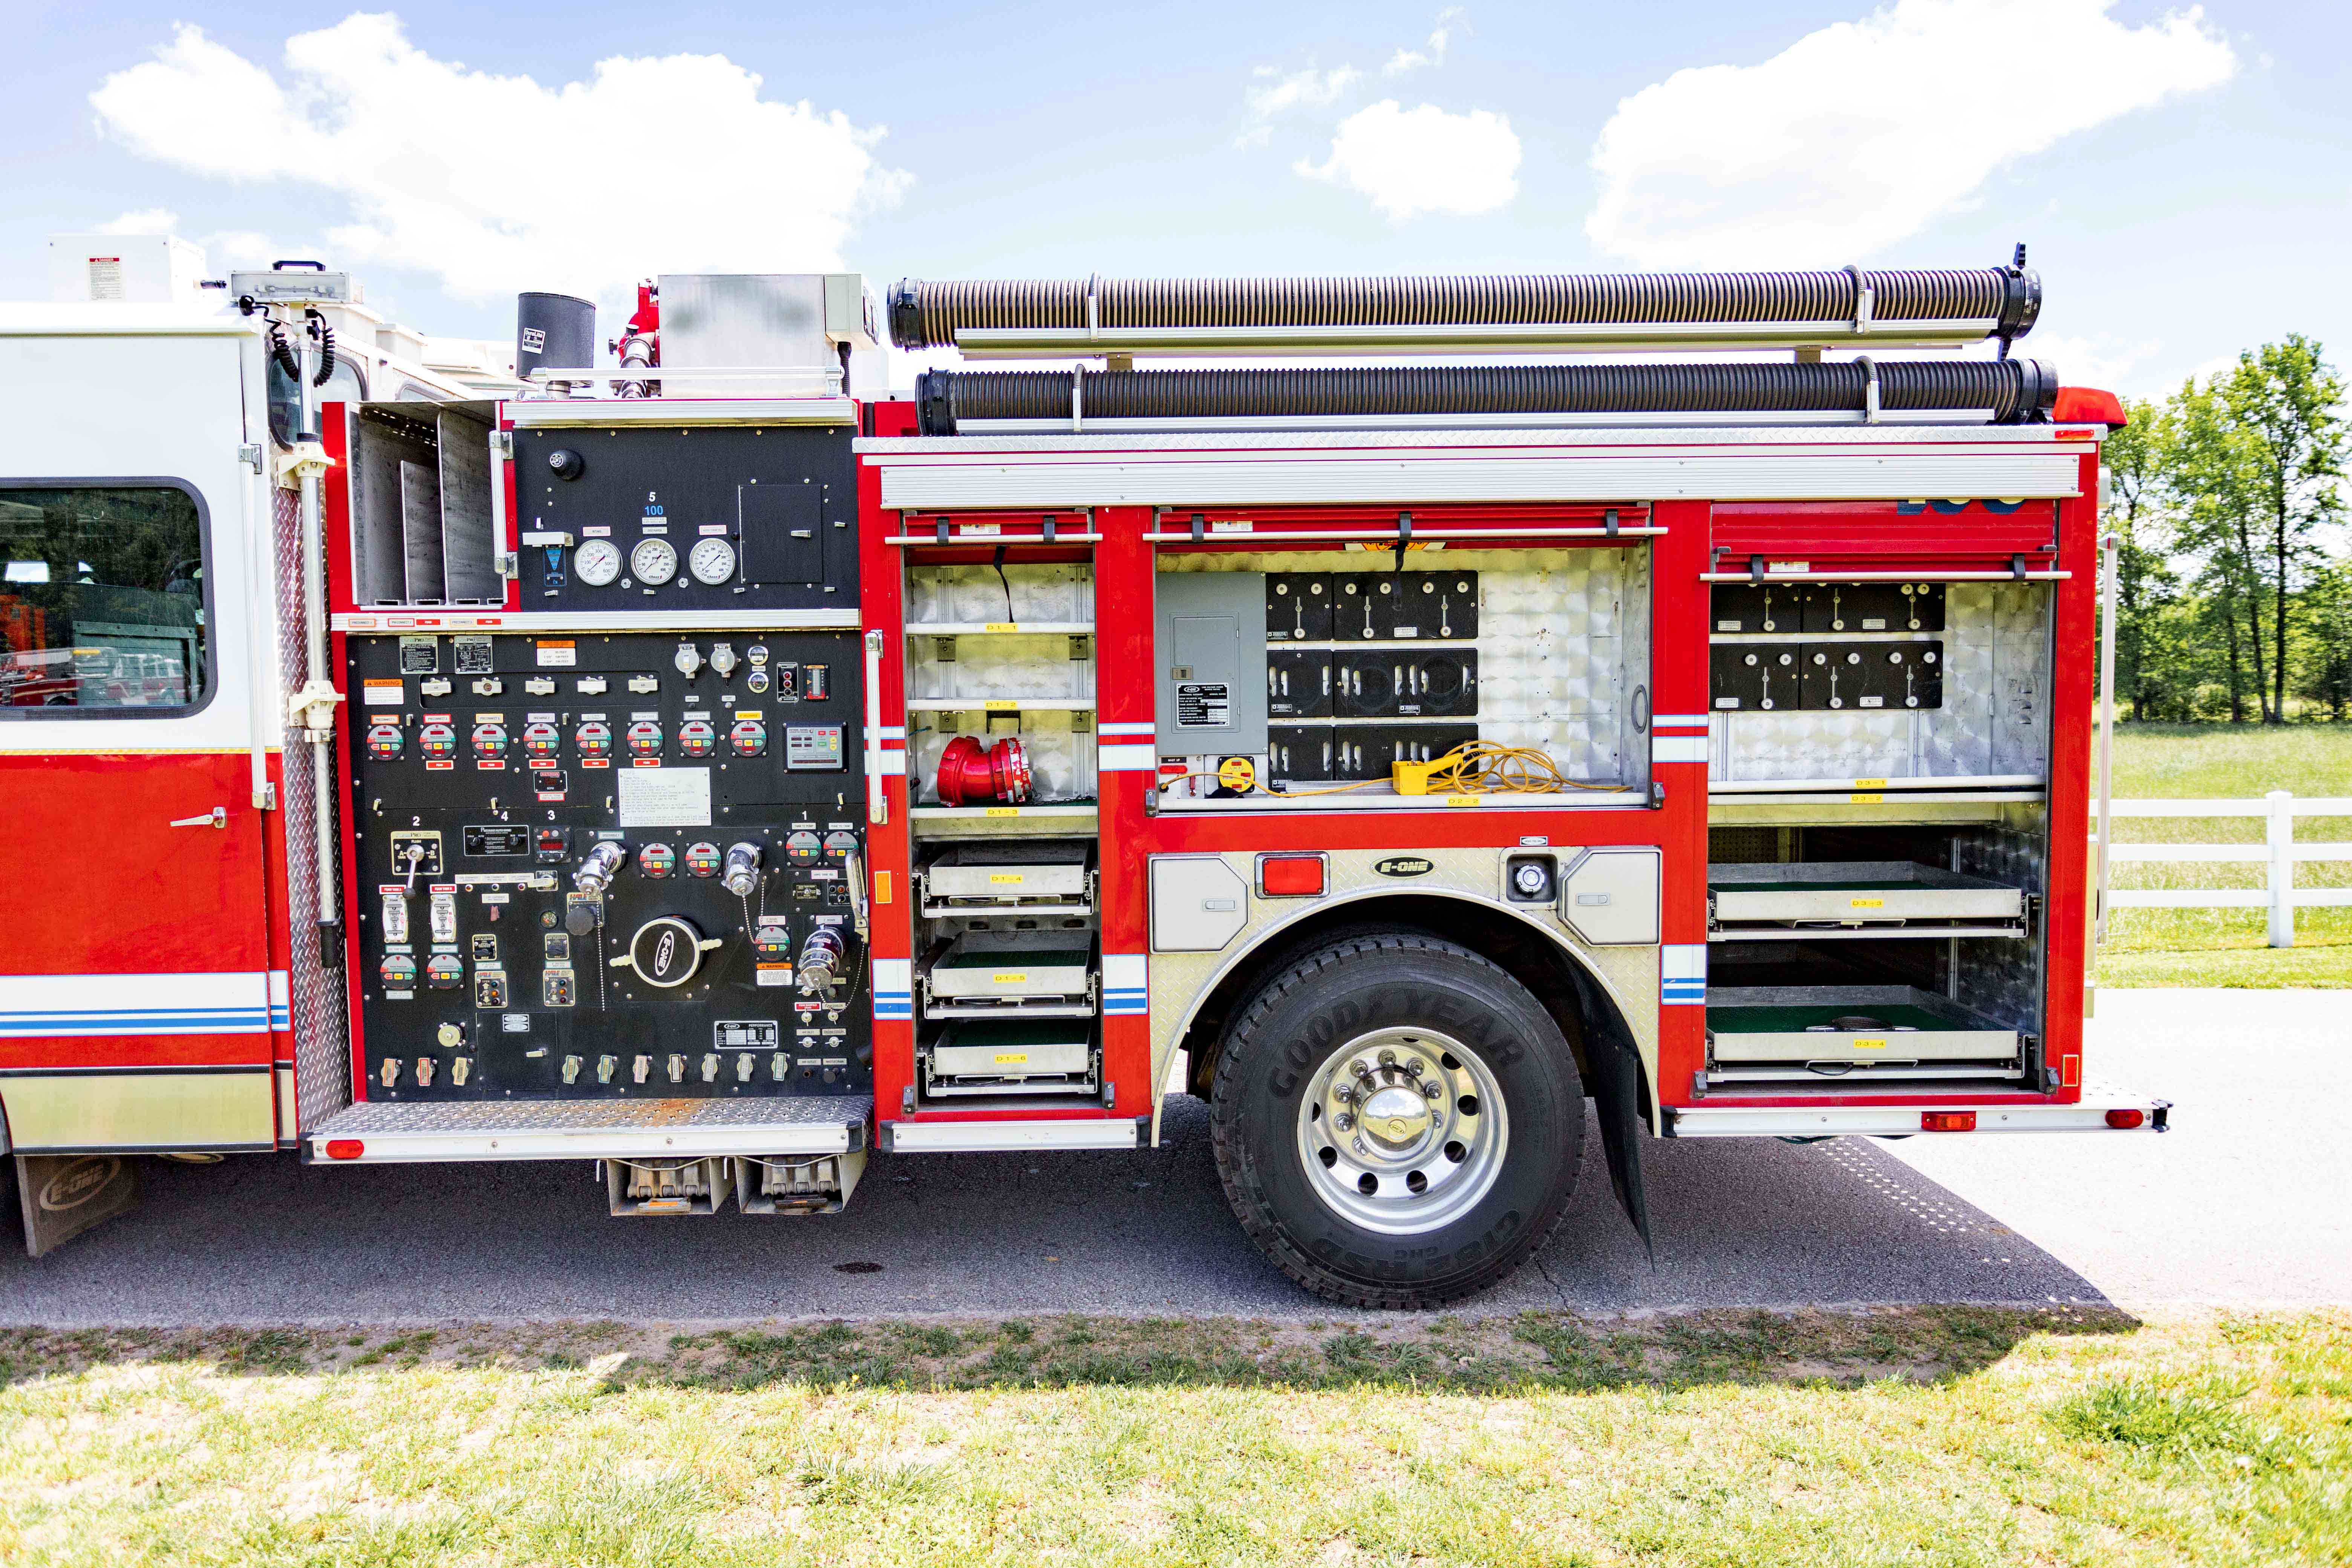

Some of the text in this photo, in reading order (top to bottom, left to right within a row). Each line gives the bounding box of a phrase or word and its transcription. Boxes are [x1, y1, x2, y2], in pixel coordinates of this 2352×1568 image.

[648, 492, 656, 502] 5
[645, 505, 664, 516] 100
[501, 811, 508, 821] 4
[548, 810, 555, 820] 3
[802, 810, 807, 820] 1
[412, 816, 420, 826] 2
[1380, 862, 1428, 873] E-ONE
[657, 937, 672, 969] E-ONE
